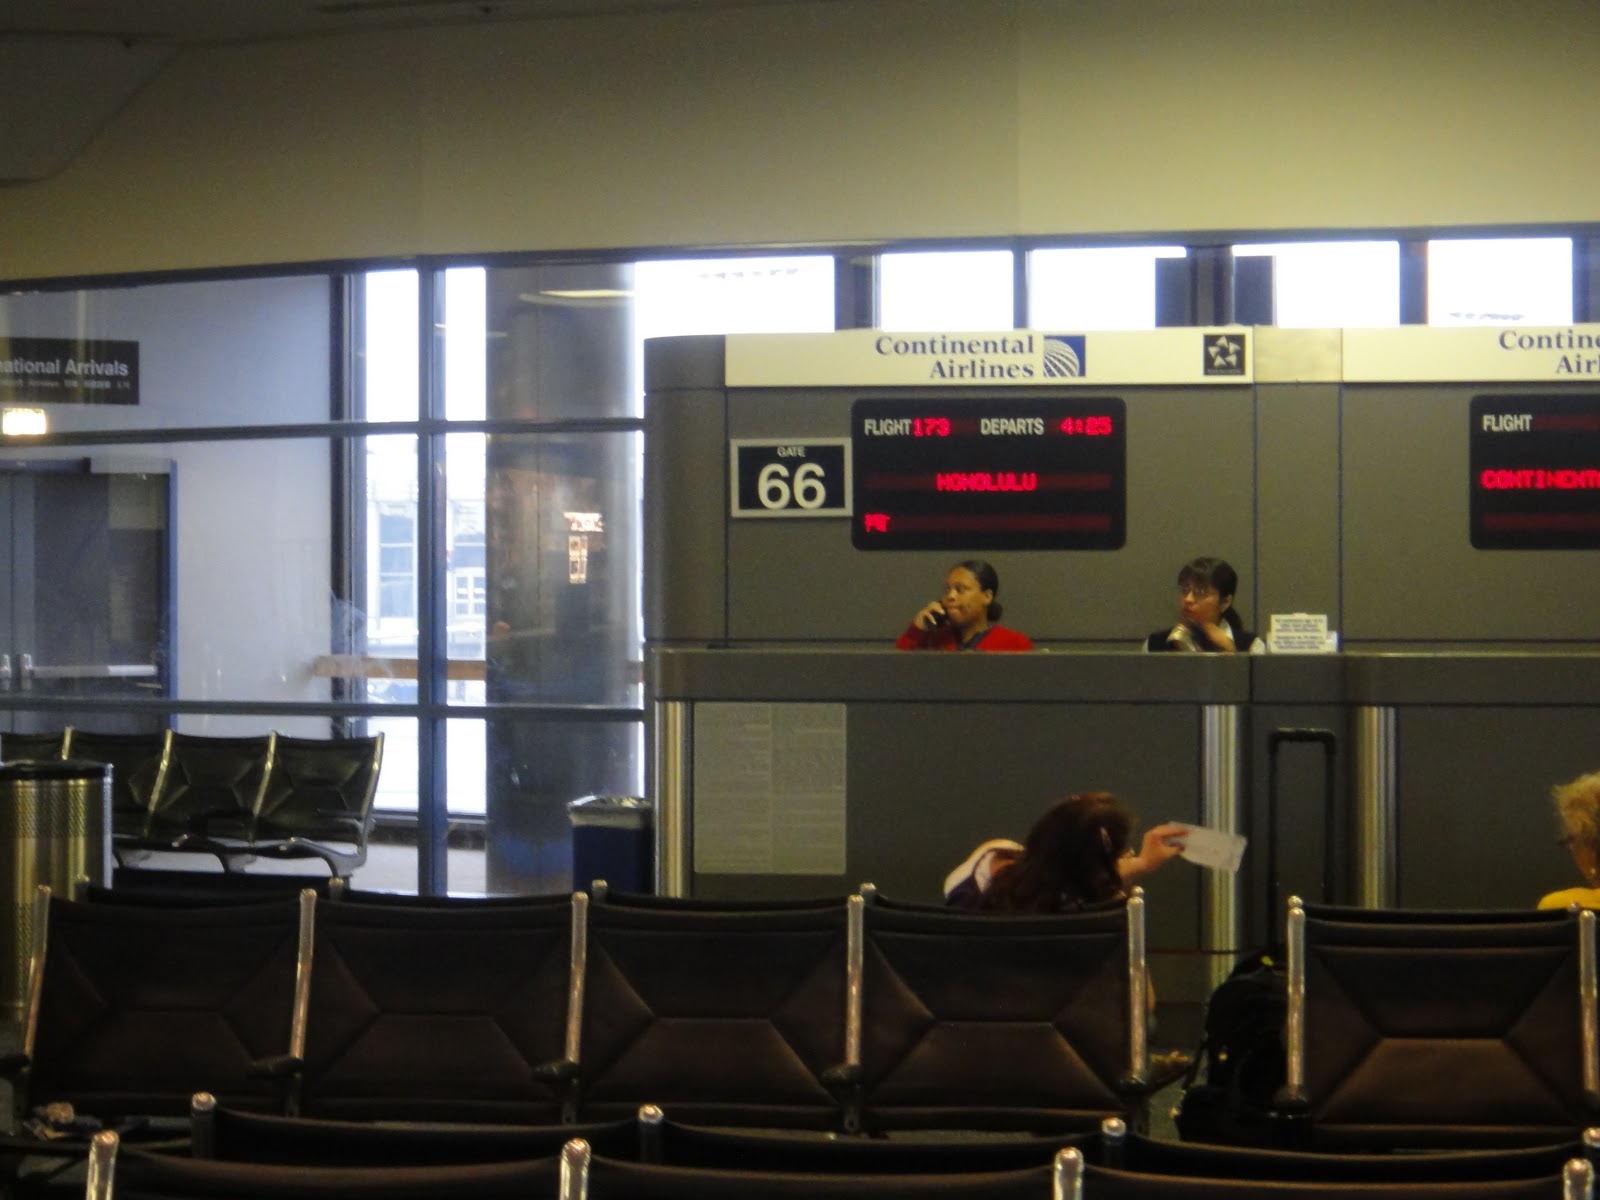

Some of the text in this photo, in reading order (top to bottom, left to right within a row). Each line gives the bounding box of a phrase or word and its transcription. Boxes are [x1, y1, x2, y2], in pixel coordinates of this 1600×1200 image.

[875, 335, 1034, 355] Continental
[65, 360, 129, 376] Arrivals
[929, 358, 1034, 378] Airlines
[864, 418, 951, 436] FLIGHT 173
[980, 417, 1044, 435] DEPARTS
[1482, 414, 1533, 432] FLIGHT
[777, 446, 806, 458] GATE
[758, 463, 826, 509] 66
[936, 472, 1037, 492] HONOLULU
